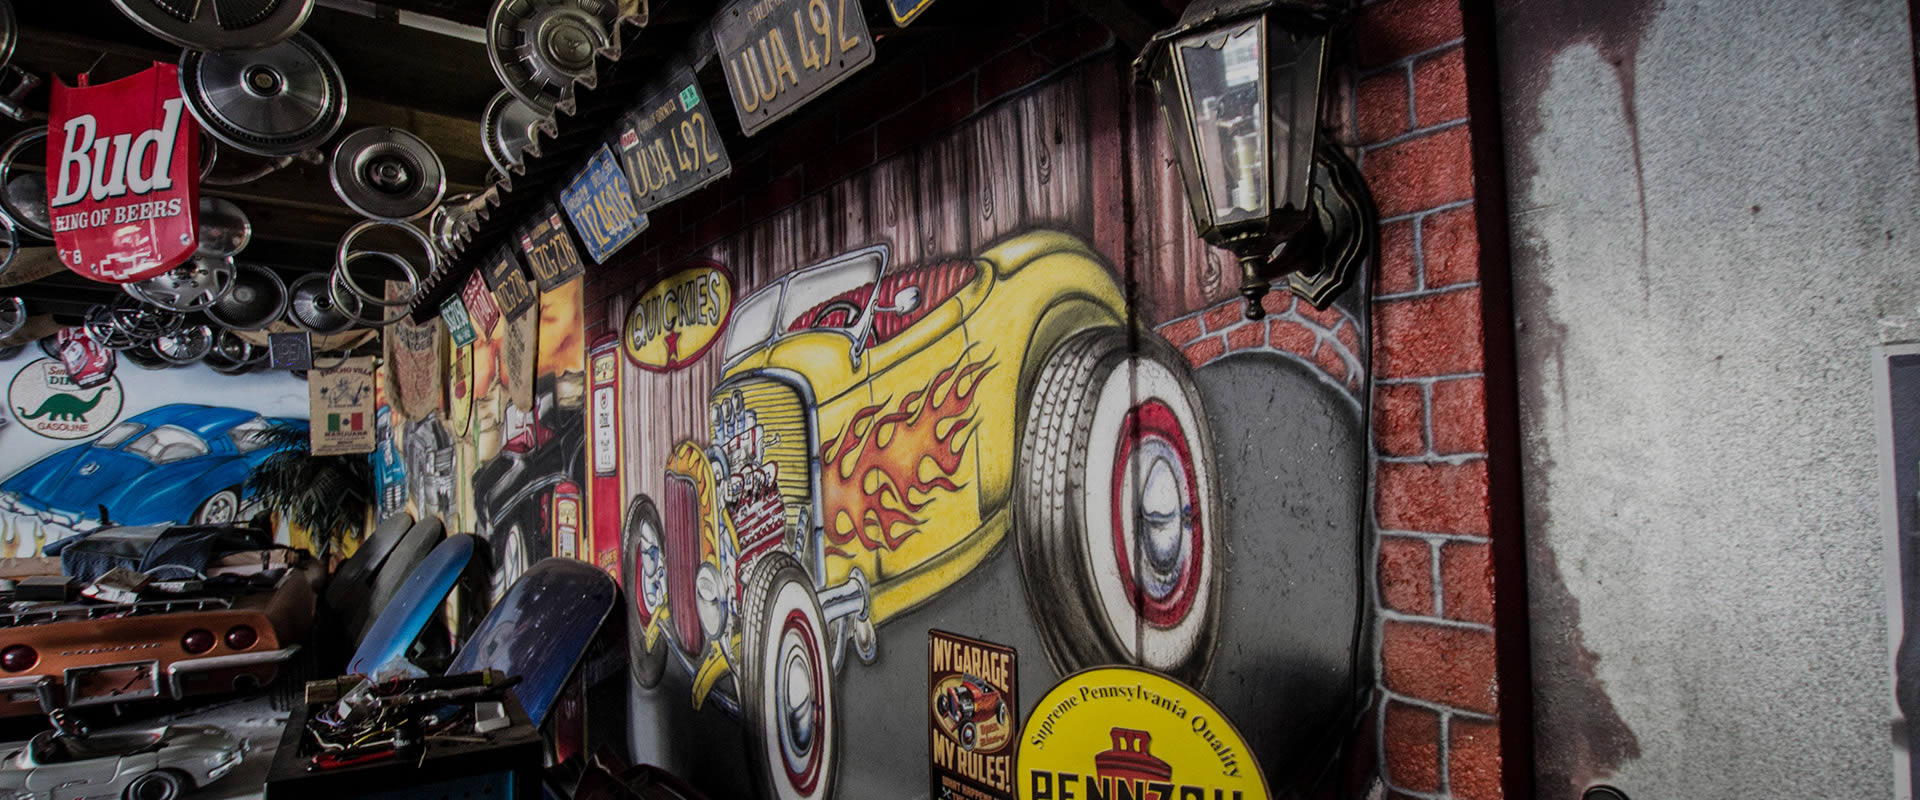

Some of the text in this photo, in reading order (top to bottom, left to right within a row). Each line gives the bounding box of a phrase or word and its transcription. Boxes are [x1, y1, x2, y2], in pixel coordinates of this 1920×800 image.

[730, 0, 859, 113] UUA 492
[52, 97, 184, 208] Bud
[627, 112, 719, 198] UUA 492
[56, 198, 184, 232] KING OF BEERS
[528, 243, 559, 280] NZG
[550, 232, 577, 271] 278
[632, 270, 721, 351] QUICKIES
[37, 421, 89, 432] GASOLINE
[933, 637, 1009, 694] MY GARAGE
[933, 728, 954, 770] MY
[957, 747, 1011, 793] RULES!
[1031, 695, 1080, 750] Supreme
[1079, 683, 1187, 719] Pennsylvania
[1191, 715, 1243, 779] Quality
[1031, 769, 1244, 800] PENN
